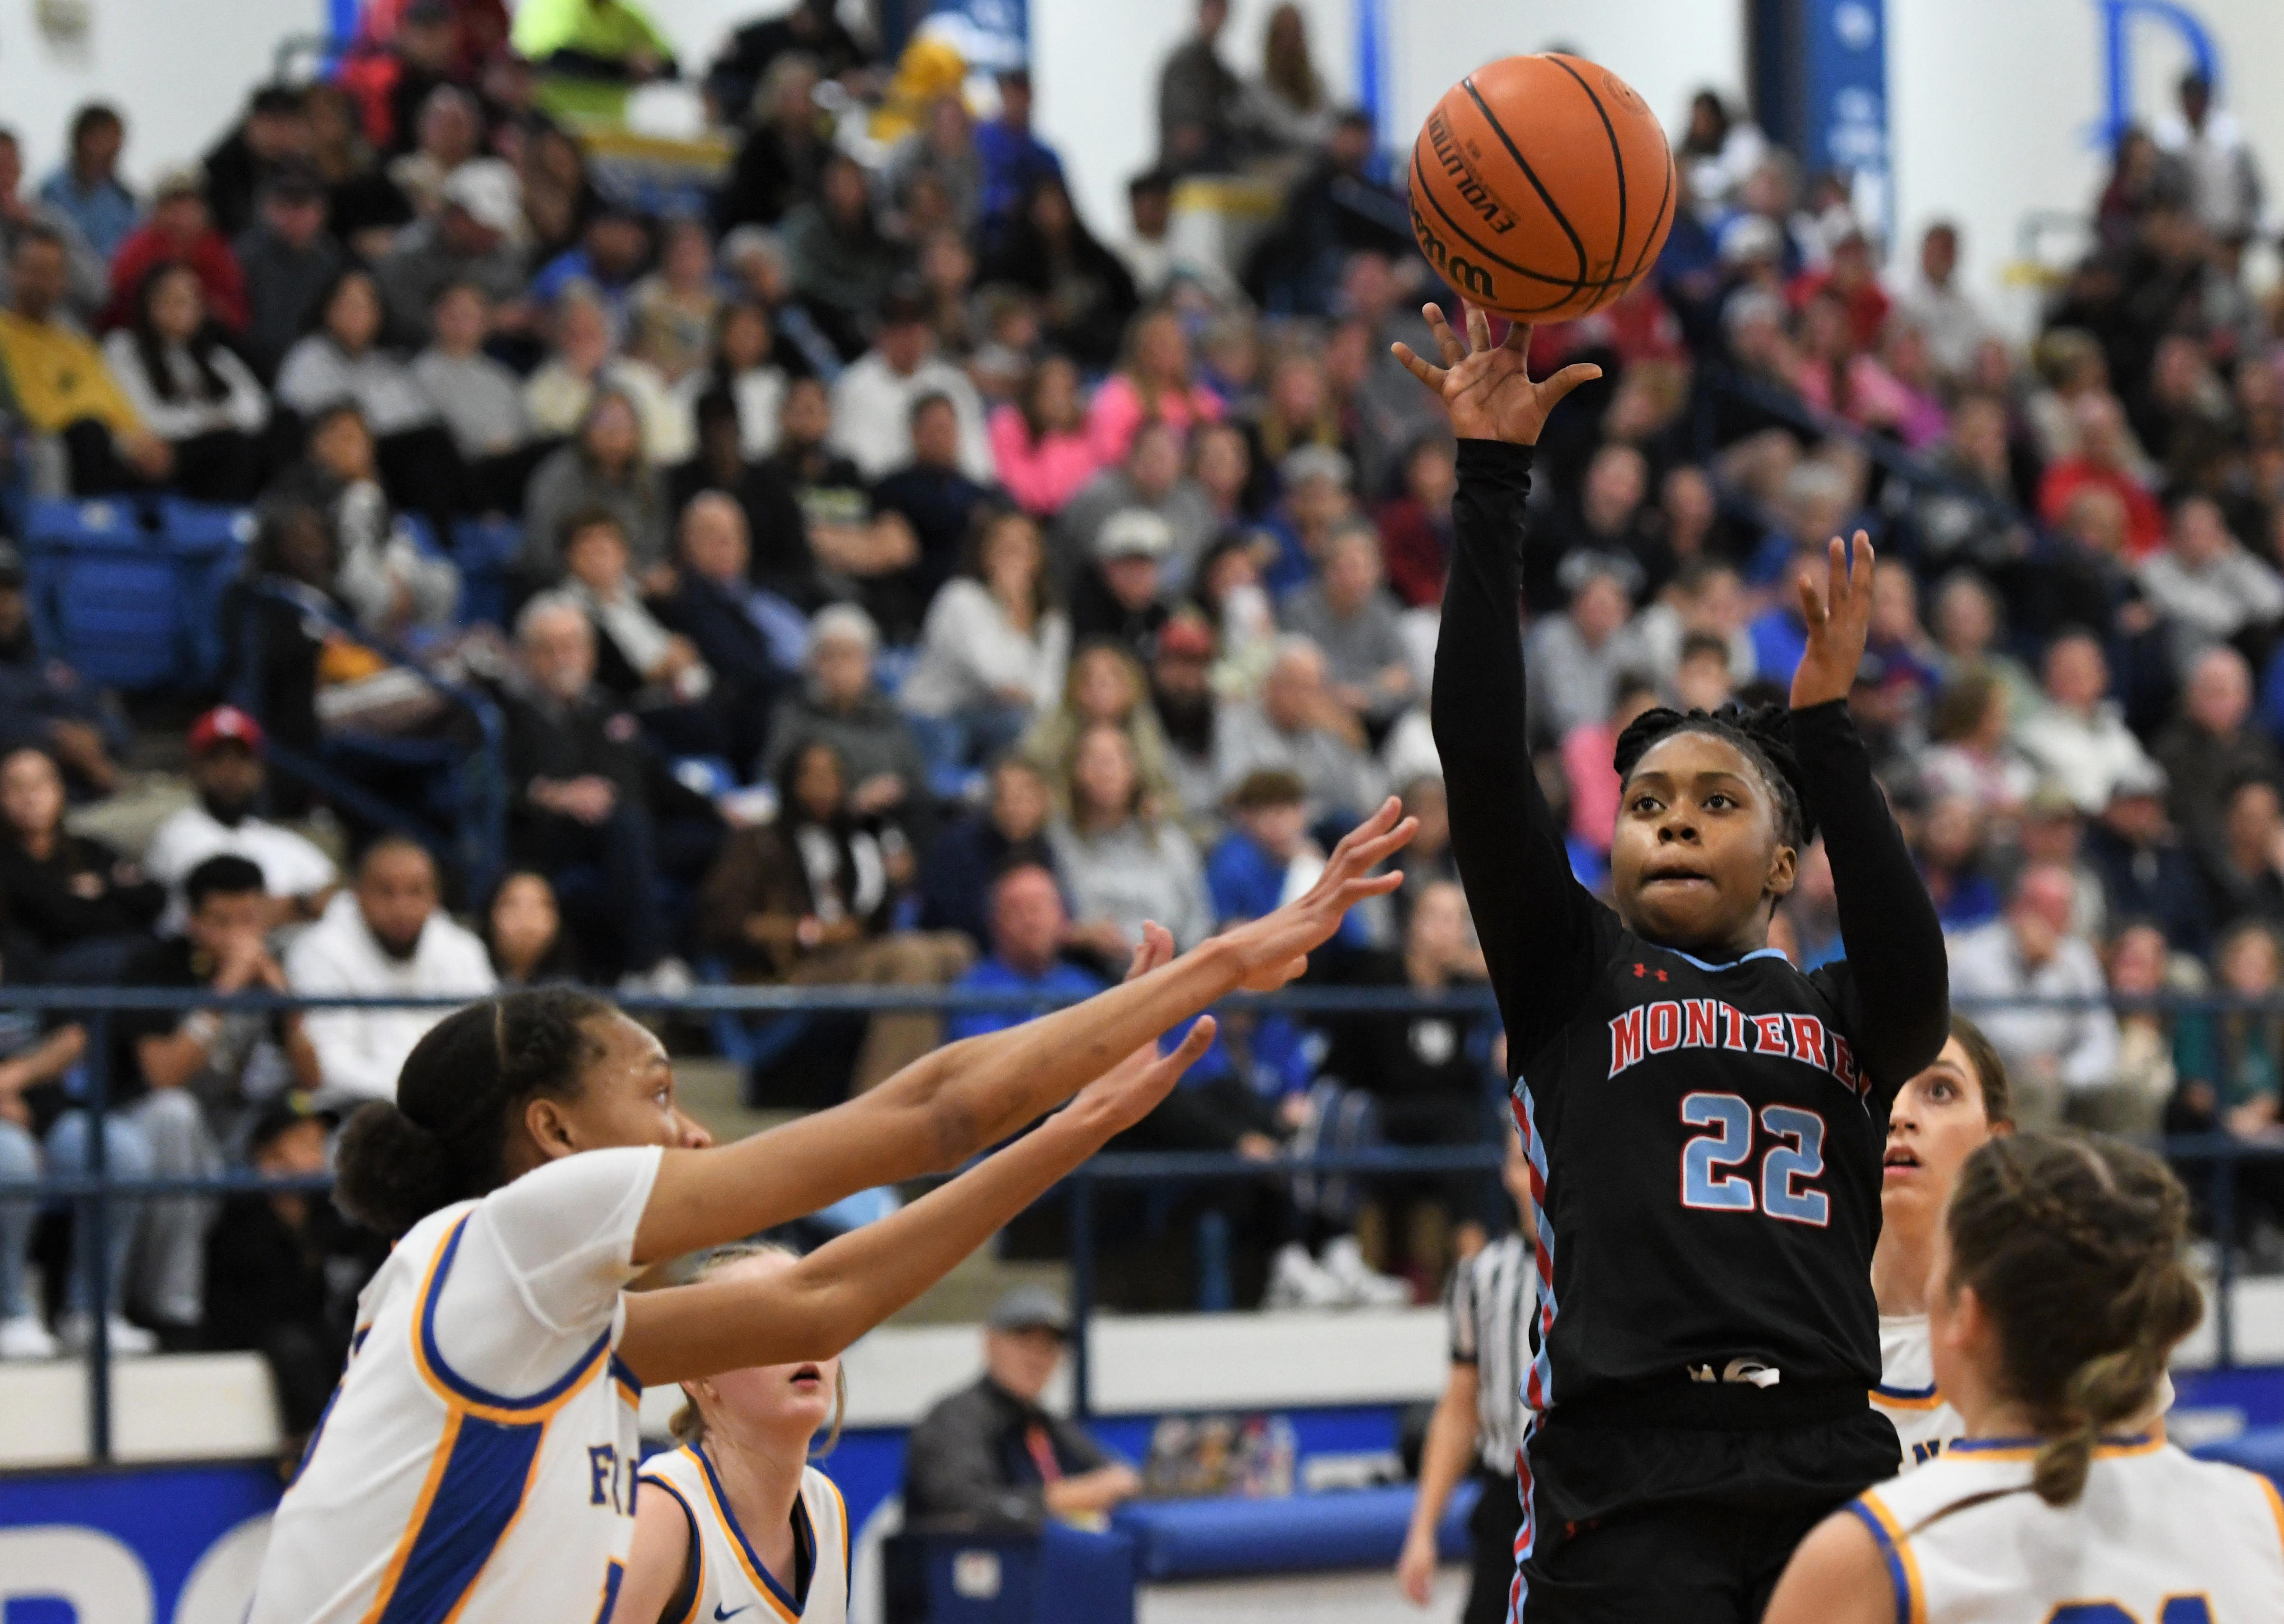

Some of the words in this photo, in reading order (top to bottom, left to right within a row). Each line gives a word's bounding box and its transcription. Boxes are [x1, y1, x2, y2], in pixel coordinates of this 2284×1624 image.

[1428, 108, 1517, 234] EVOLUTION
[1607, 998, 1872, 1106] MONTERE
[1680, 1091, 1829, 1228] 22
